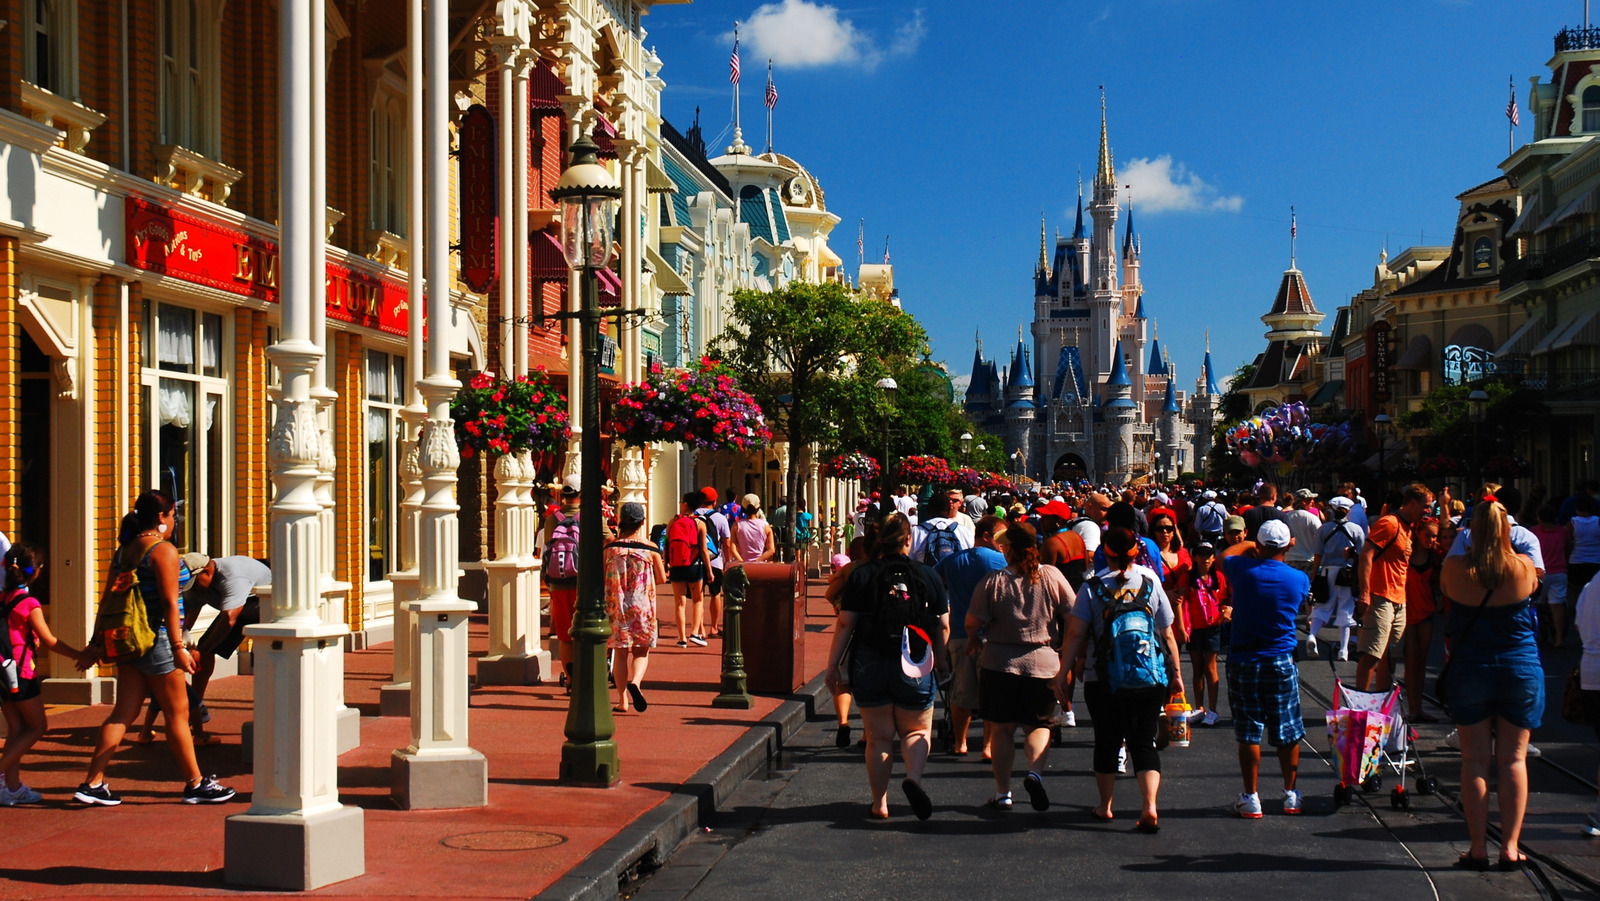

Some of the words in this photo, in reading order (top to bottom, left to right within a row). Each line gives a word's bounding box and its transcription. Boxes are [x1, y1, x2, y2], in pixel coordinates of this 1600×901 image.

[467, 126, 488, 269] EMPORIUM
[179, 243, 186, 256] &
[232, 242, 378, 317] EMIUM
[1377, 331, 1385, 367] CRYSTAL
[1377, 371, 1385, 392] ARTS
